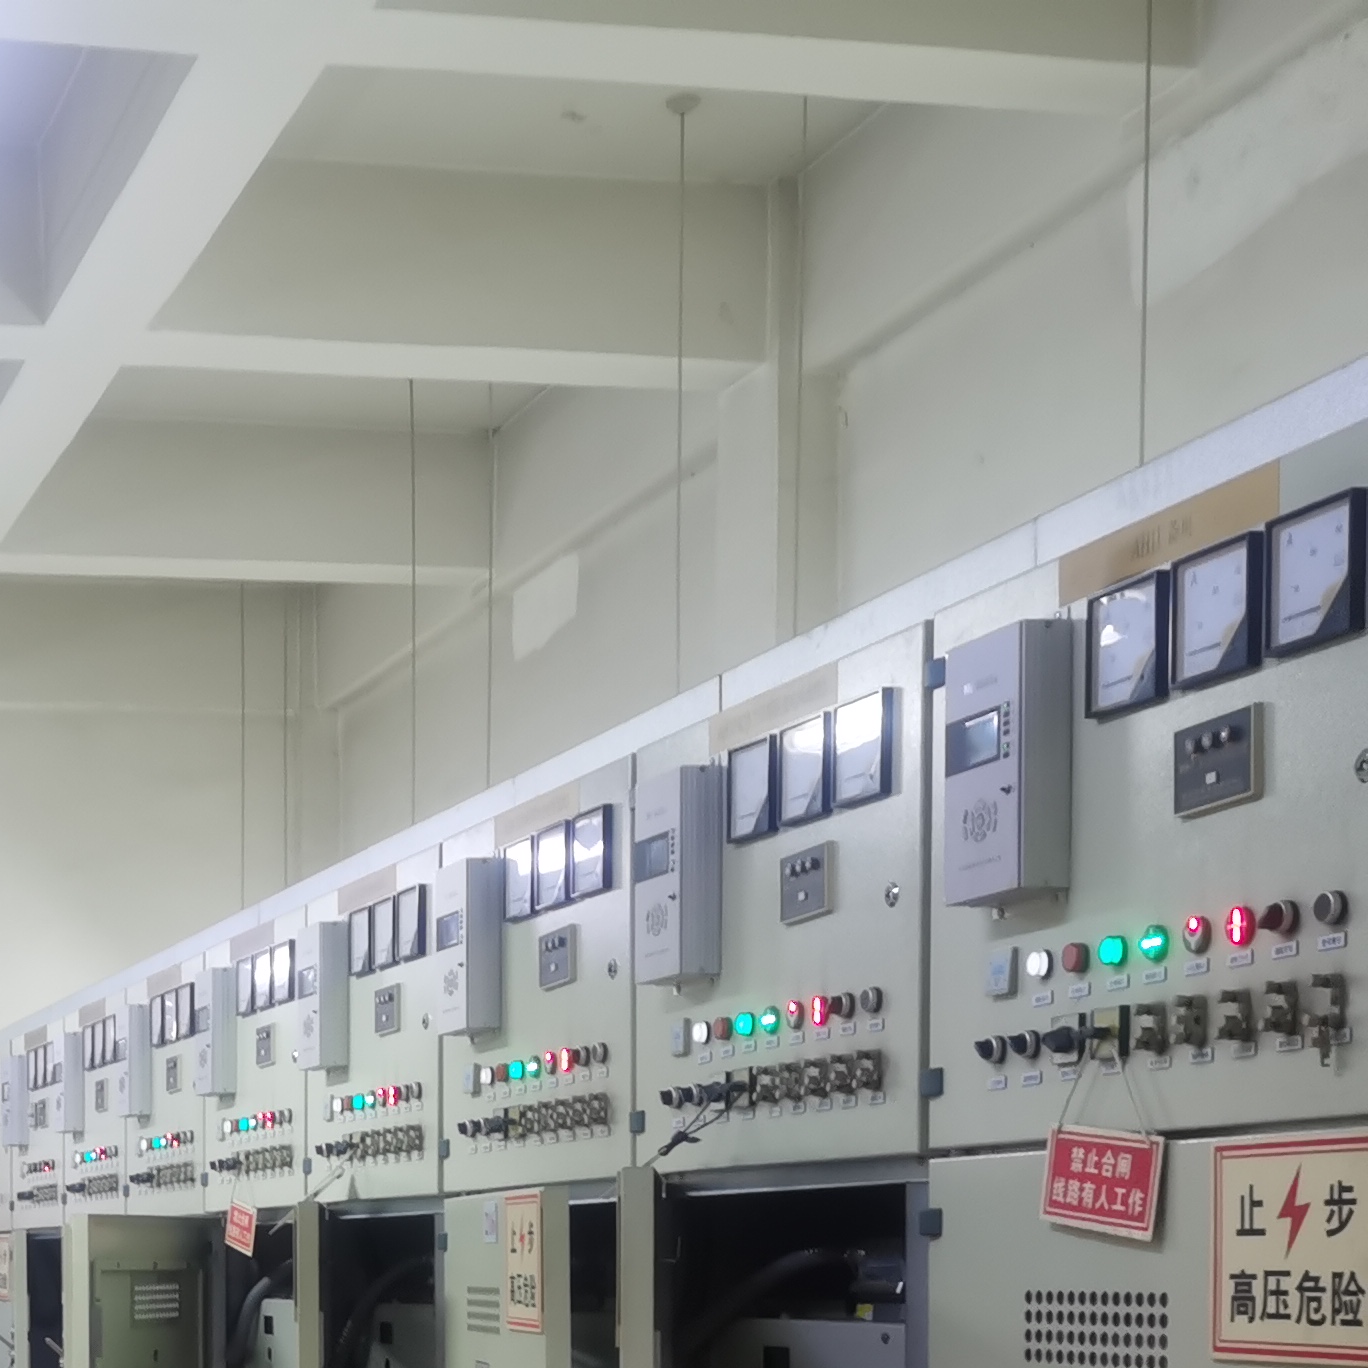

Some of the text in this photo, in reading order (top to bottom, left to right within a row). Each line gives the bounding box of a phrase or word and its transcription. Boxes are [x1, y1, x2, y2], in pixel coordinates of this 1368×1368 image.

[1070, 1145, 1134, 1181] 禁止合闸
[1051, 1177, 1146, 1218] 线路有人工作
[1234, 1179, 1359, 1239] 止 步
[1228, 1268, 1367, 1329] 高压危险
